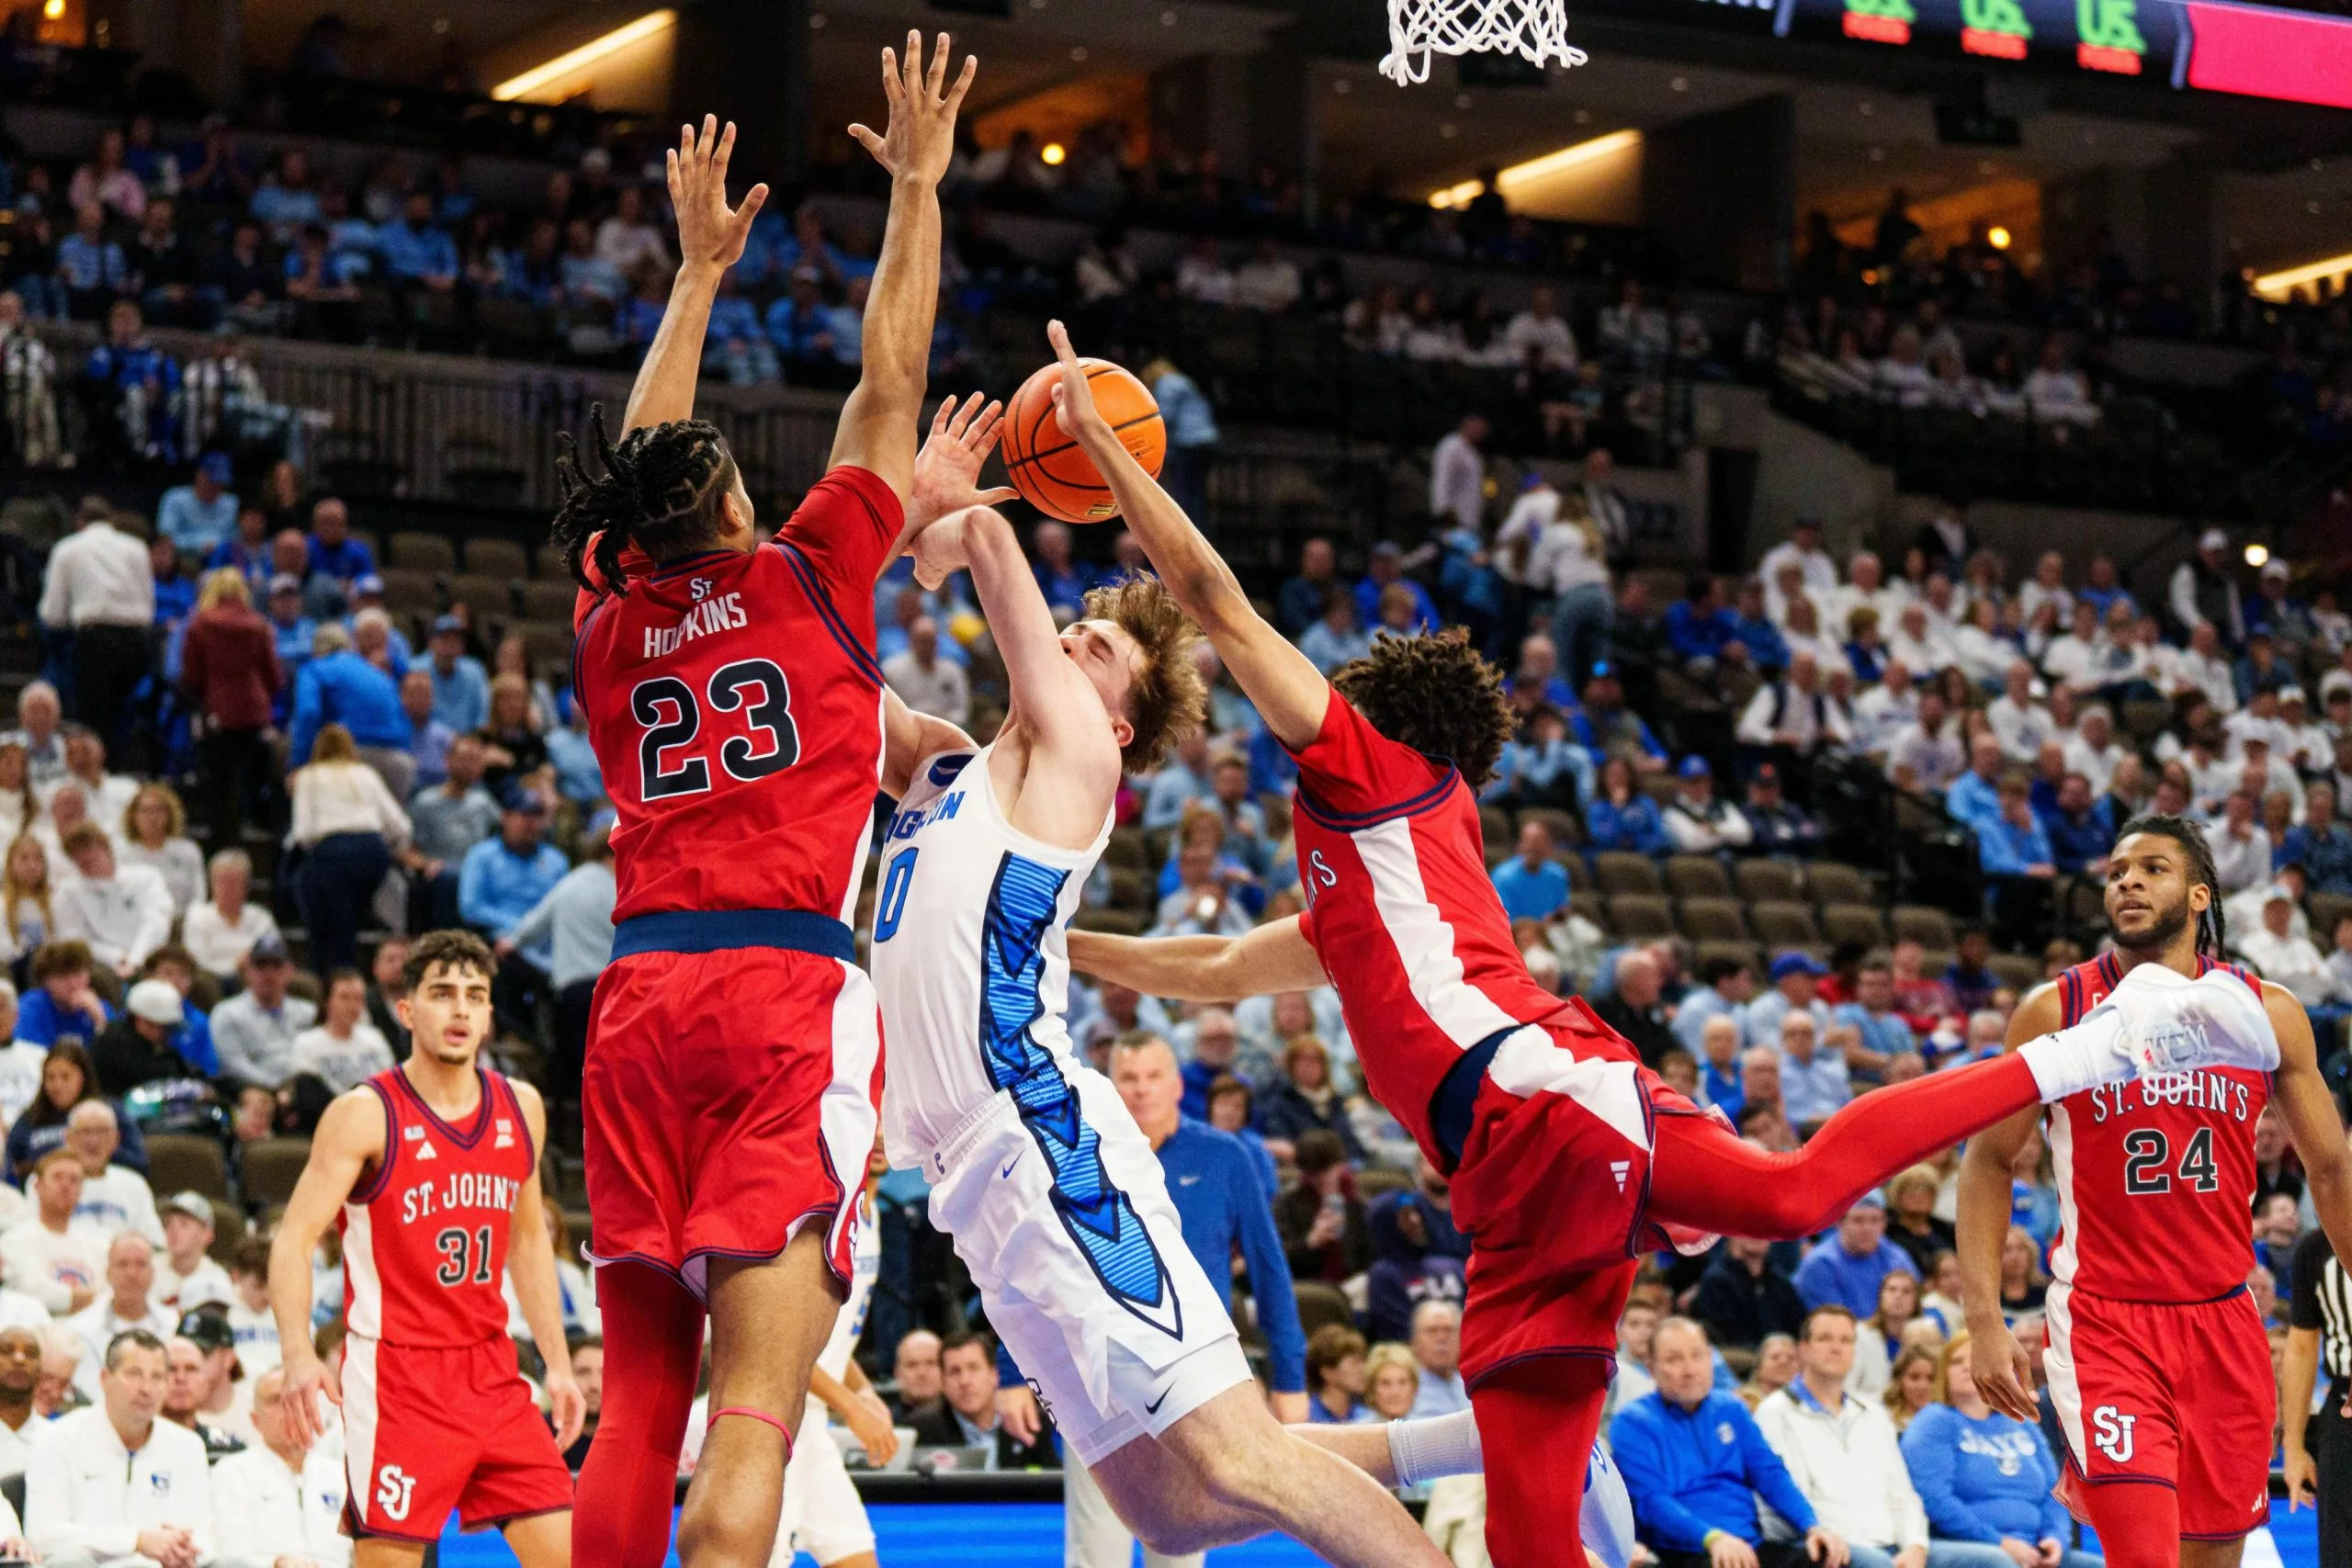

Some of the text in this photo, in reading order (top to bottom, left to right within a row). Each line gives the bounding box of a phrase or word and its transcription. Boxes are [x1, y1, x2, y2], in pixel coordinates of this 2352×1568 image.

[643, 592, 748, 658] HOPKINS
[630, 658, 800, 802] 23
[874, 846, 920, 943] 0
[2091, 1069, 2249, 1123] ST. JOHN'S
[2123, 1127, 2219, 1195] 24
[402, 1180, 436, 1224] ST.
[436, 1225, 492, 1286] 31
